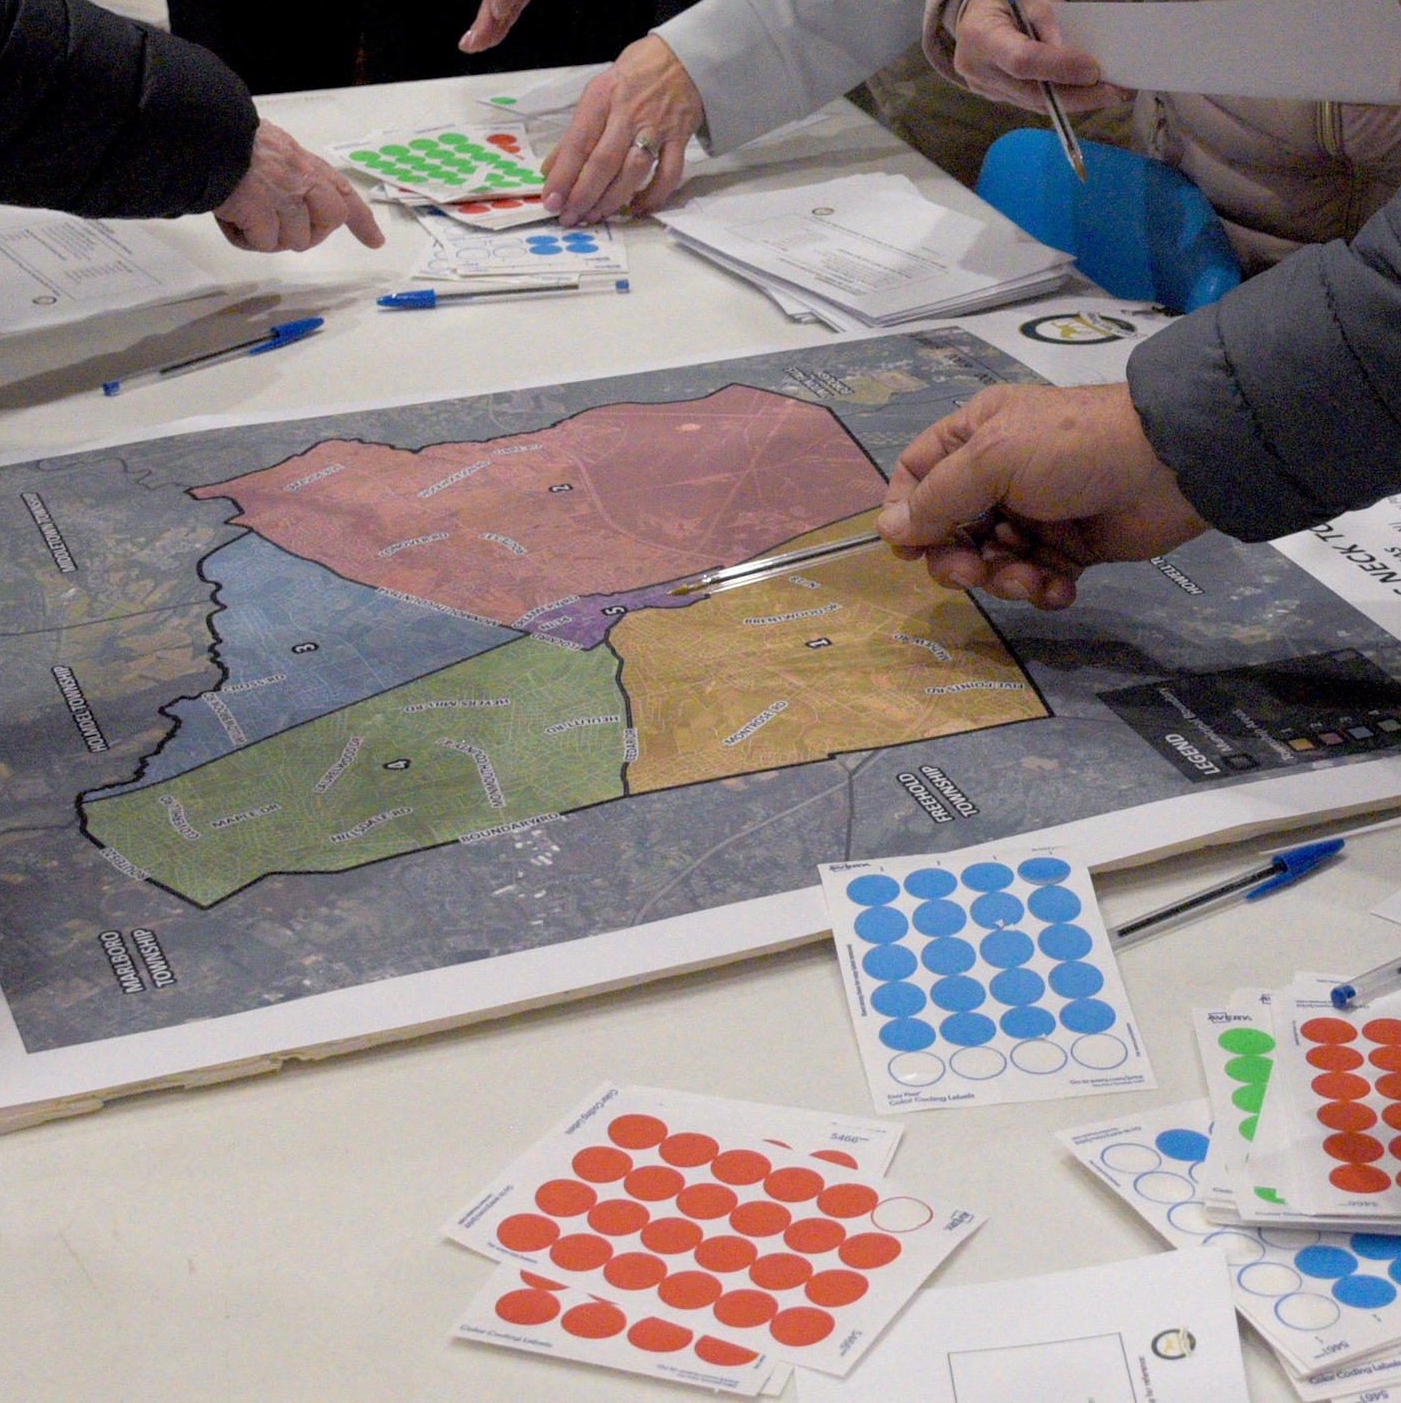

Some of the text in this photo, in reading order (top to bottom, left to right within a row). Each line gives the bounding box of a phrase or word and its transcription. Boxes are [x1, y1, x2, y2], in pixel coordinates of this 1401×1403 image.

[549, 483, 573, 492] 2
[1158, 565, 1202, 595] HOWELL
[602, 605, 625, 614] 5
[293, 642, 317, 653] 3
[806, 639, 829, 647] 1
[52, 664, 108, 752] HOLMDEL TOWNSHIP
[724, 710, 775, 743] MONTROSE
[1187, 718, 1235, 751] Municipal
[385, 759, 410, 770] 4
[1165, 733, 1219, 774] LEGEND
[898, 774, 953, 823] FREEHOLD
[921, 766, 977, 817] TOWNSHIP
[330, 811, 392, 842] HILLSDALE
[458, 818, 539, 842] BOUNDARY
[99, 930, 144, 993] MARLBORO
[132, 927, 176, 986] TOWNSHIP
[830, 1132, 859, 1143] 5466
[1309, 1373, 1336, 1385] Color
[1337, 1367, 1371, 1380] Coding
